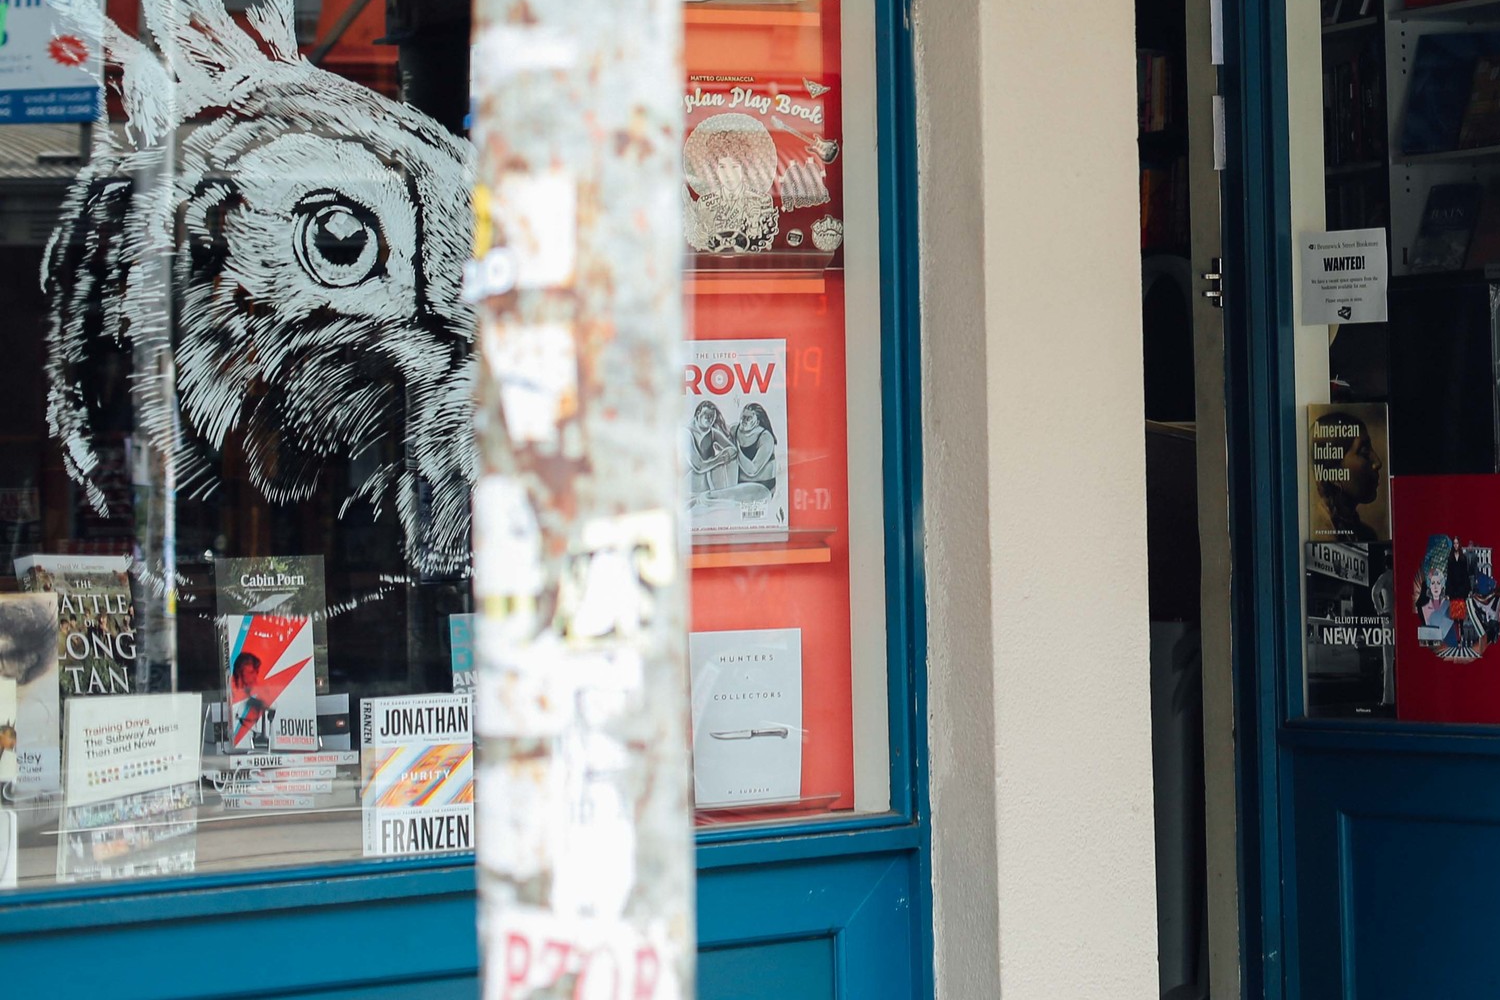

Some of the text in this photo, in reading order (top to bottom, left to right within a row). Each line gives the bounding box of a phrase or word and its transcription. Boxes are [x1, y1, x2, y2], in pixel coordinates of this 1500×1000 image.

[716, 75, 755, 83] GUARNACCIA
[684, 86, 823, 125] ylan Play Book
[1317, 242, 1341, 250] Brunswick
[1342, 241, 1356, 249] Street
[1323, 256, 1365, 271] WANTED!
[683, 362, 776, 396] ROW
[1313, 420, 1360, 438] American
[1313, 442, 1344, 460] Indian
[1313, 463, 1350, 482] Women
[74, 580, 92, 589] THE
[240, 573, 305, 587] Cabin Porn
[60, 593, 129, 615] ATTLE
[1334, 616, 1390, 625] ELLIOTT ERWITT'S
[1323, 627, 1357, 645] NEW
[720, 654, 775, 663] HUNTERS
[65, 666, 130, 694] TAN
[713, 691, 783, 701] COLLECTORS
[83, 717, 151, 737] Training Days
[280, 718, 315, 737] BOWIE
[363, 701, 372, 745] FRANZEN
[380, 705, 469, 737] JONATHAN
[84, 738, 103, 748] The
[105, 729, 145, 745] Subway
[86, 738, 156, 760] Then and Now
[253, 757, 283, 767] BOWIE
[303, 755, 318, 764] SIMON
[401, 769, 450, 782] PURITY
[224, 797, 240, 808] WIE
[381, 814, 470, 853] FRANZEN
